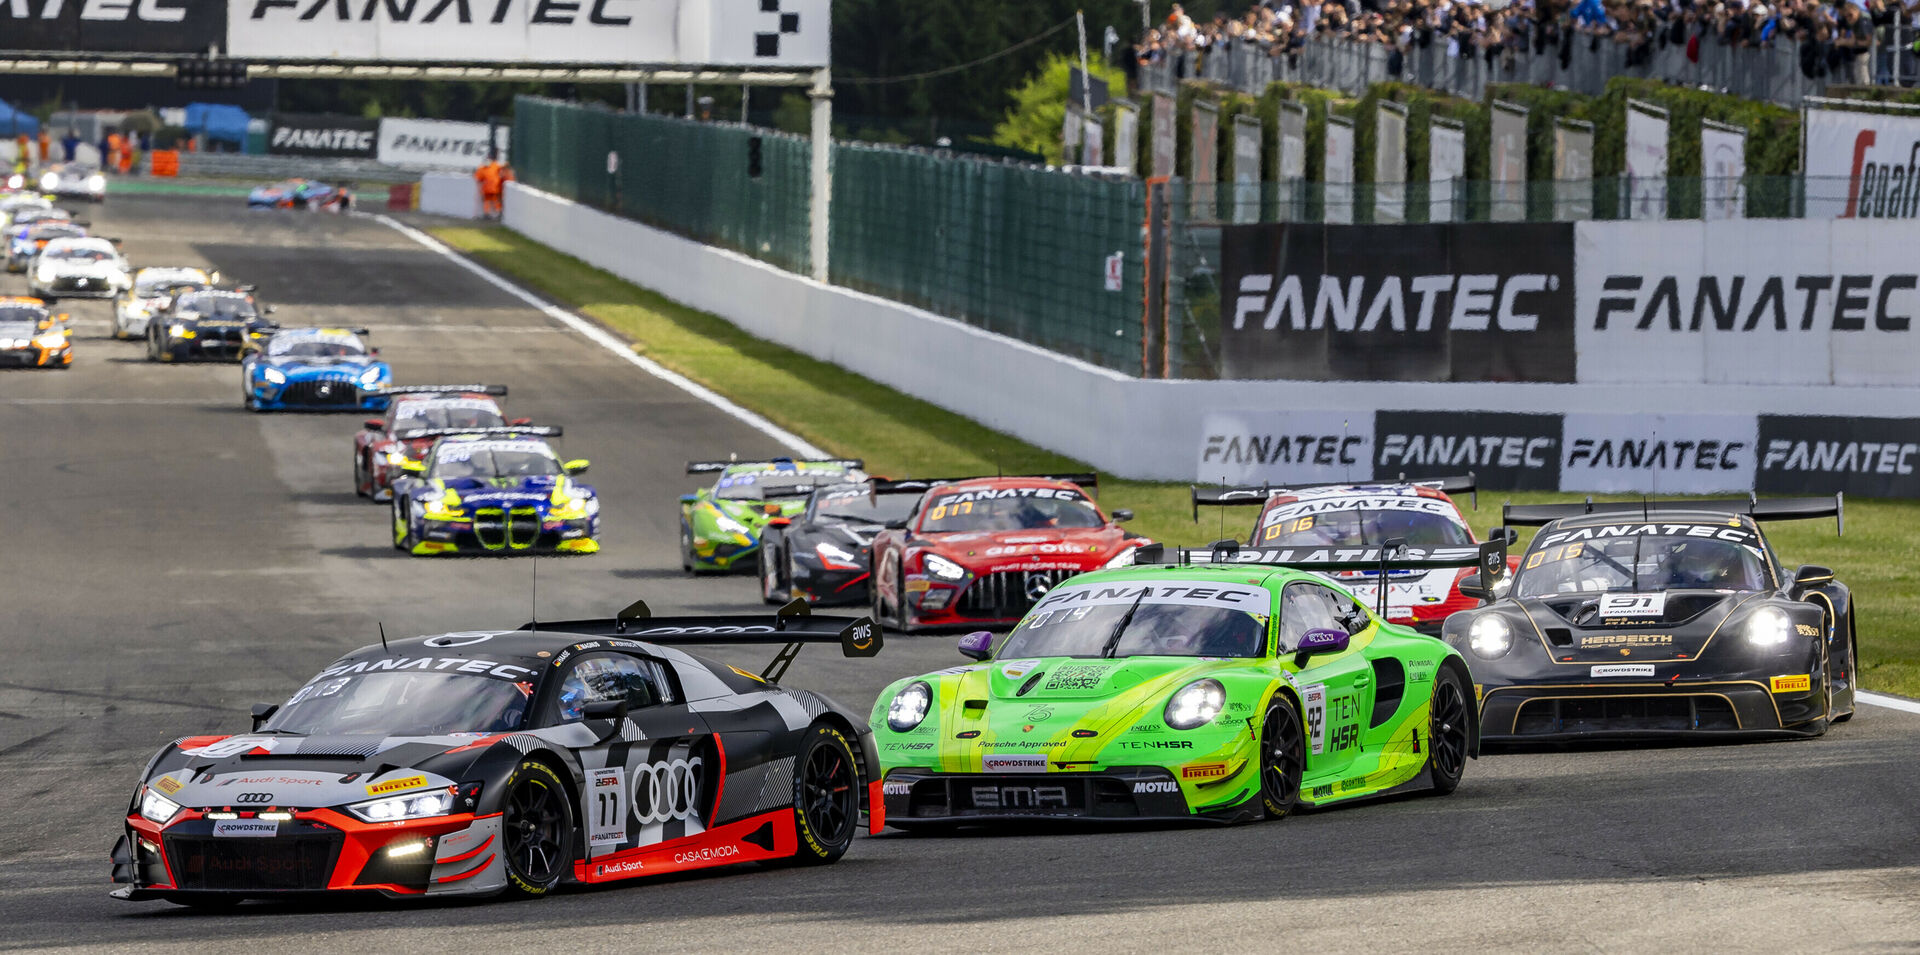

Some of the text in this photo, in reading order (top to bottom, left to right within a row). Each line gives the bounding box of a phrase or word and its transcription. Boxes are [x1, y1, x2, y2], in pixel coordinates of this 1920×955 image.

[272, 127, 375, 150] FANATEC
[391, 134, 490, 157] FANATEC
[1233, 274, 1549, 332] FANATEC
[1593, 275, 1919, 332] FANATEC
[1203, 434, 1364, 466] FANATEC
[1379, 434, 1556, 468] FANATEC
[1567, 438, 1745, 471] FANATEC
[1763, 439, 1920, 475] FANATEC
[938, 488, 1076, 507] FANATEC
[1271, 498, 1446, 524] FANATEC
[1539, 523, 1751, 550] FANATEC
[1487, 551, 1501, 566] aws
[1036, 586, 1252, 610] FANATEC
[1352, 584, 1433, 597] ROVE
[852, 624, 872, 641] aws
[1581, 634, 1673, 645] HERBERTH
[312, 657, 532, 683] FANATEC
[1596, 666, 1653, 674] CROWDSTRIKE
[1775, 677, 1808, 690] PIRELLI
[1333, 692, 1361, 722] TEN
[978, 740, 1068, 750] Porsche Approved
[1330, 722, 1360, 753] HSR
[988, 759, 1046, 768] CROWDSTRIKE
[1182, 764, 1226, 778] PIRELLI
[157, 777, 180, 793] PIRELLI
[237, 776, 324, 786] Audi Sport
[371, 777, 423, 793] PIRELLI
[883, 784, 911, 795] MOTUL
[1133, 781, 1179, 793] MOTUL
[598, 792, 618, 827] 11
[221, 824, 276, 832] CROWDSTRIKE
[604, 860, 644, 874] Audi Sport
